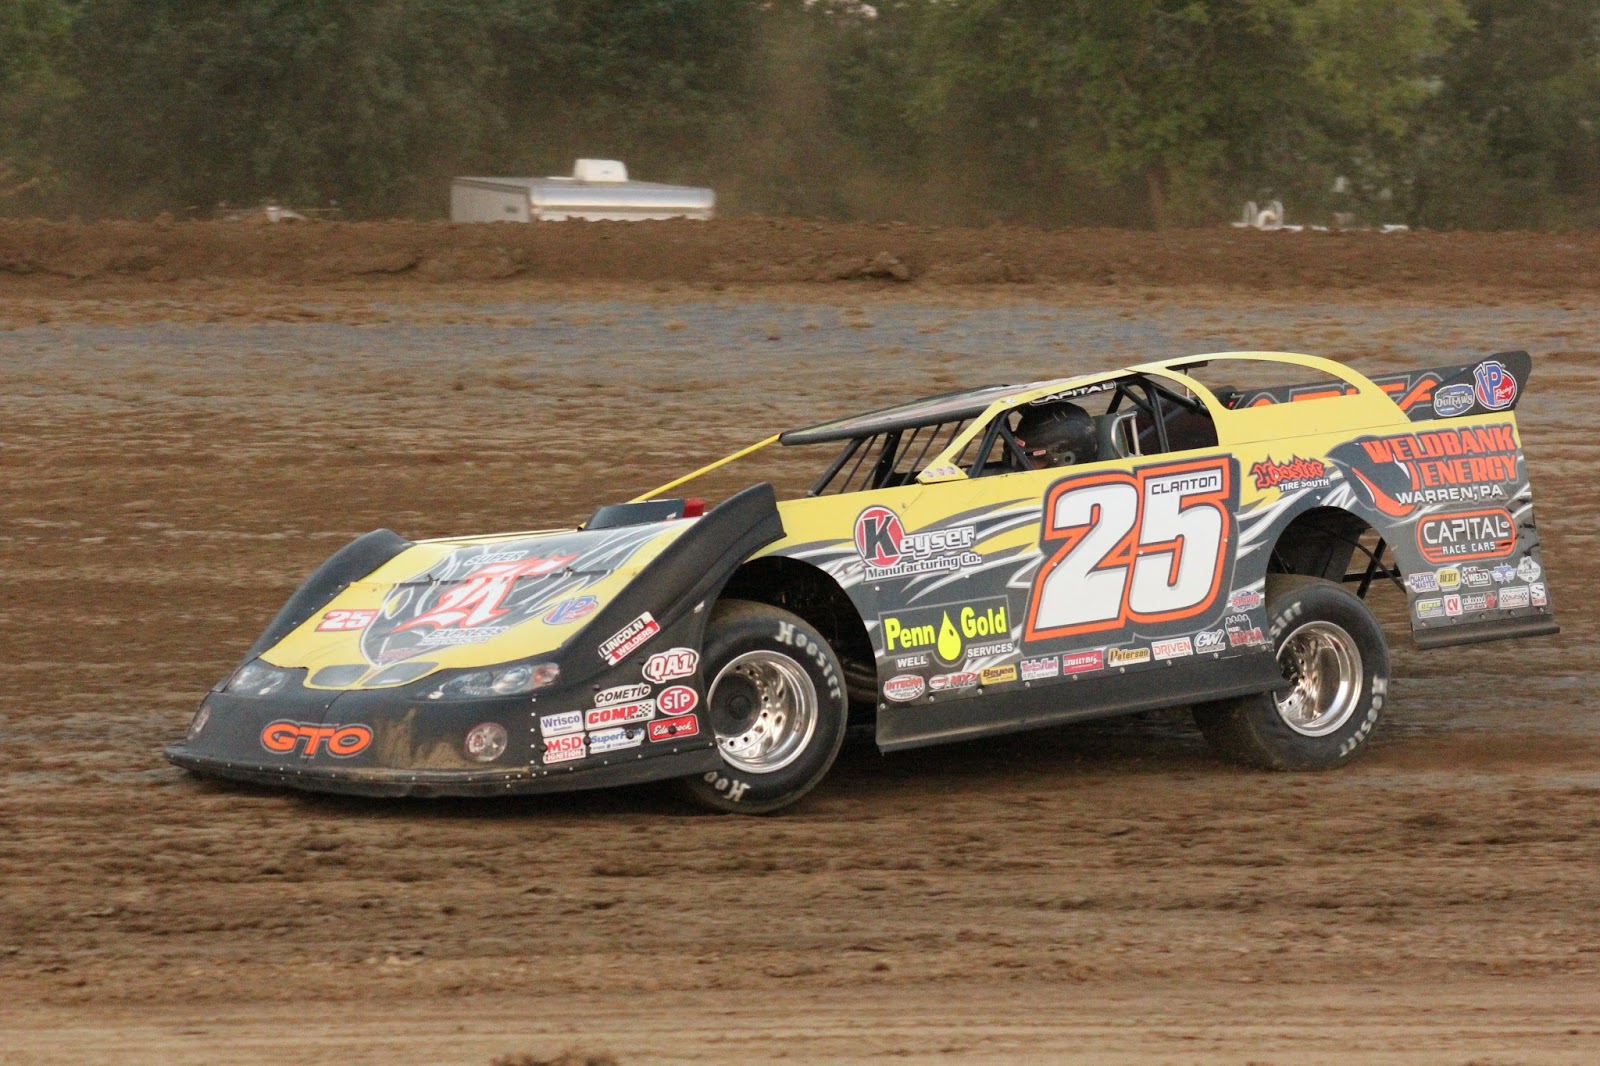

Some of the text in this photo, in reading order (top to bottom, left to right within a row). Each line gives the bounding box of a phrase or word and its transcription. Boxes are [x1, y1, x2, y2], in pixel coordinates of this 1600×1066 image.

[1475, 363, 1503, 406] VP
[1361, 424, 1517, 464] WELDBANK
[1423, 455, 1517, 488] ENERGY
[1151, 475, 1218, 495] CLANTON
[1280, 478, 1330, 492] TIRE SOUTH
[1479, 485, 1503, 499] PA
[862, 514, 975, 560] Keyser
[1423, 515, 1509, 544] CAPITAL
[1025, 458, 1230, 642] 25
[1442, 541, 1496, 555] RACE CARS
[866, 553, 982, 579] Manufacturing Co.
[1468, 572, 1489, 582] WELD
[1447, 598, 1458, 611] CV
[315, 609, 379, 631] 25
[884, 606, 1007, 651] Penn Gold
[600, 619, 645, 656] LINCOLN
[614, 626, 655, 657] WELDERS
[897, 642, 1013, 668] WELL SERVICES
[1110, 649, 1148, 662] Peterson
[1153, 641, 1191, 657] DRIVEN
[650, 652, 695, 682] QA1
[596, 685, 651, 703] COMETIC
[663, 689, 691, 710] STP
[542, 714, 580, 728] Wrisco
[588, 705, 639, 725] COMP
[261, 720, 374, 757] GTO
[547, 736, 582, 753] MSD
